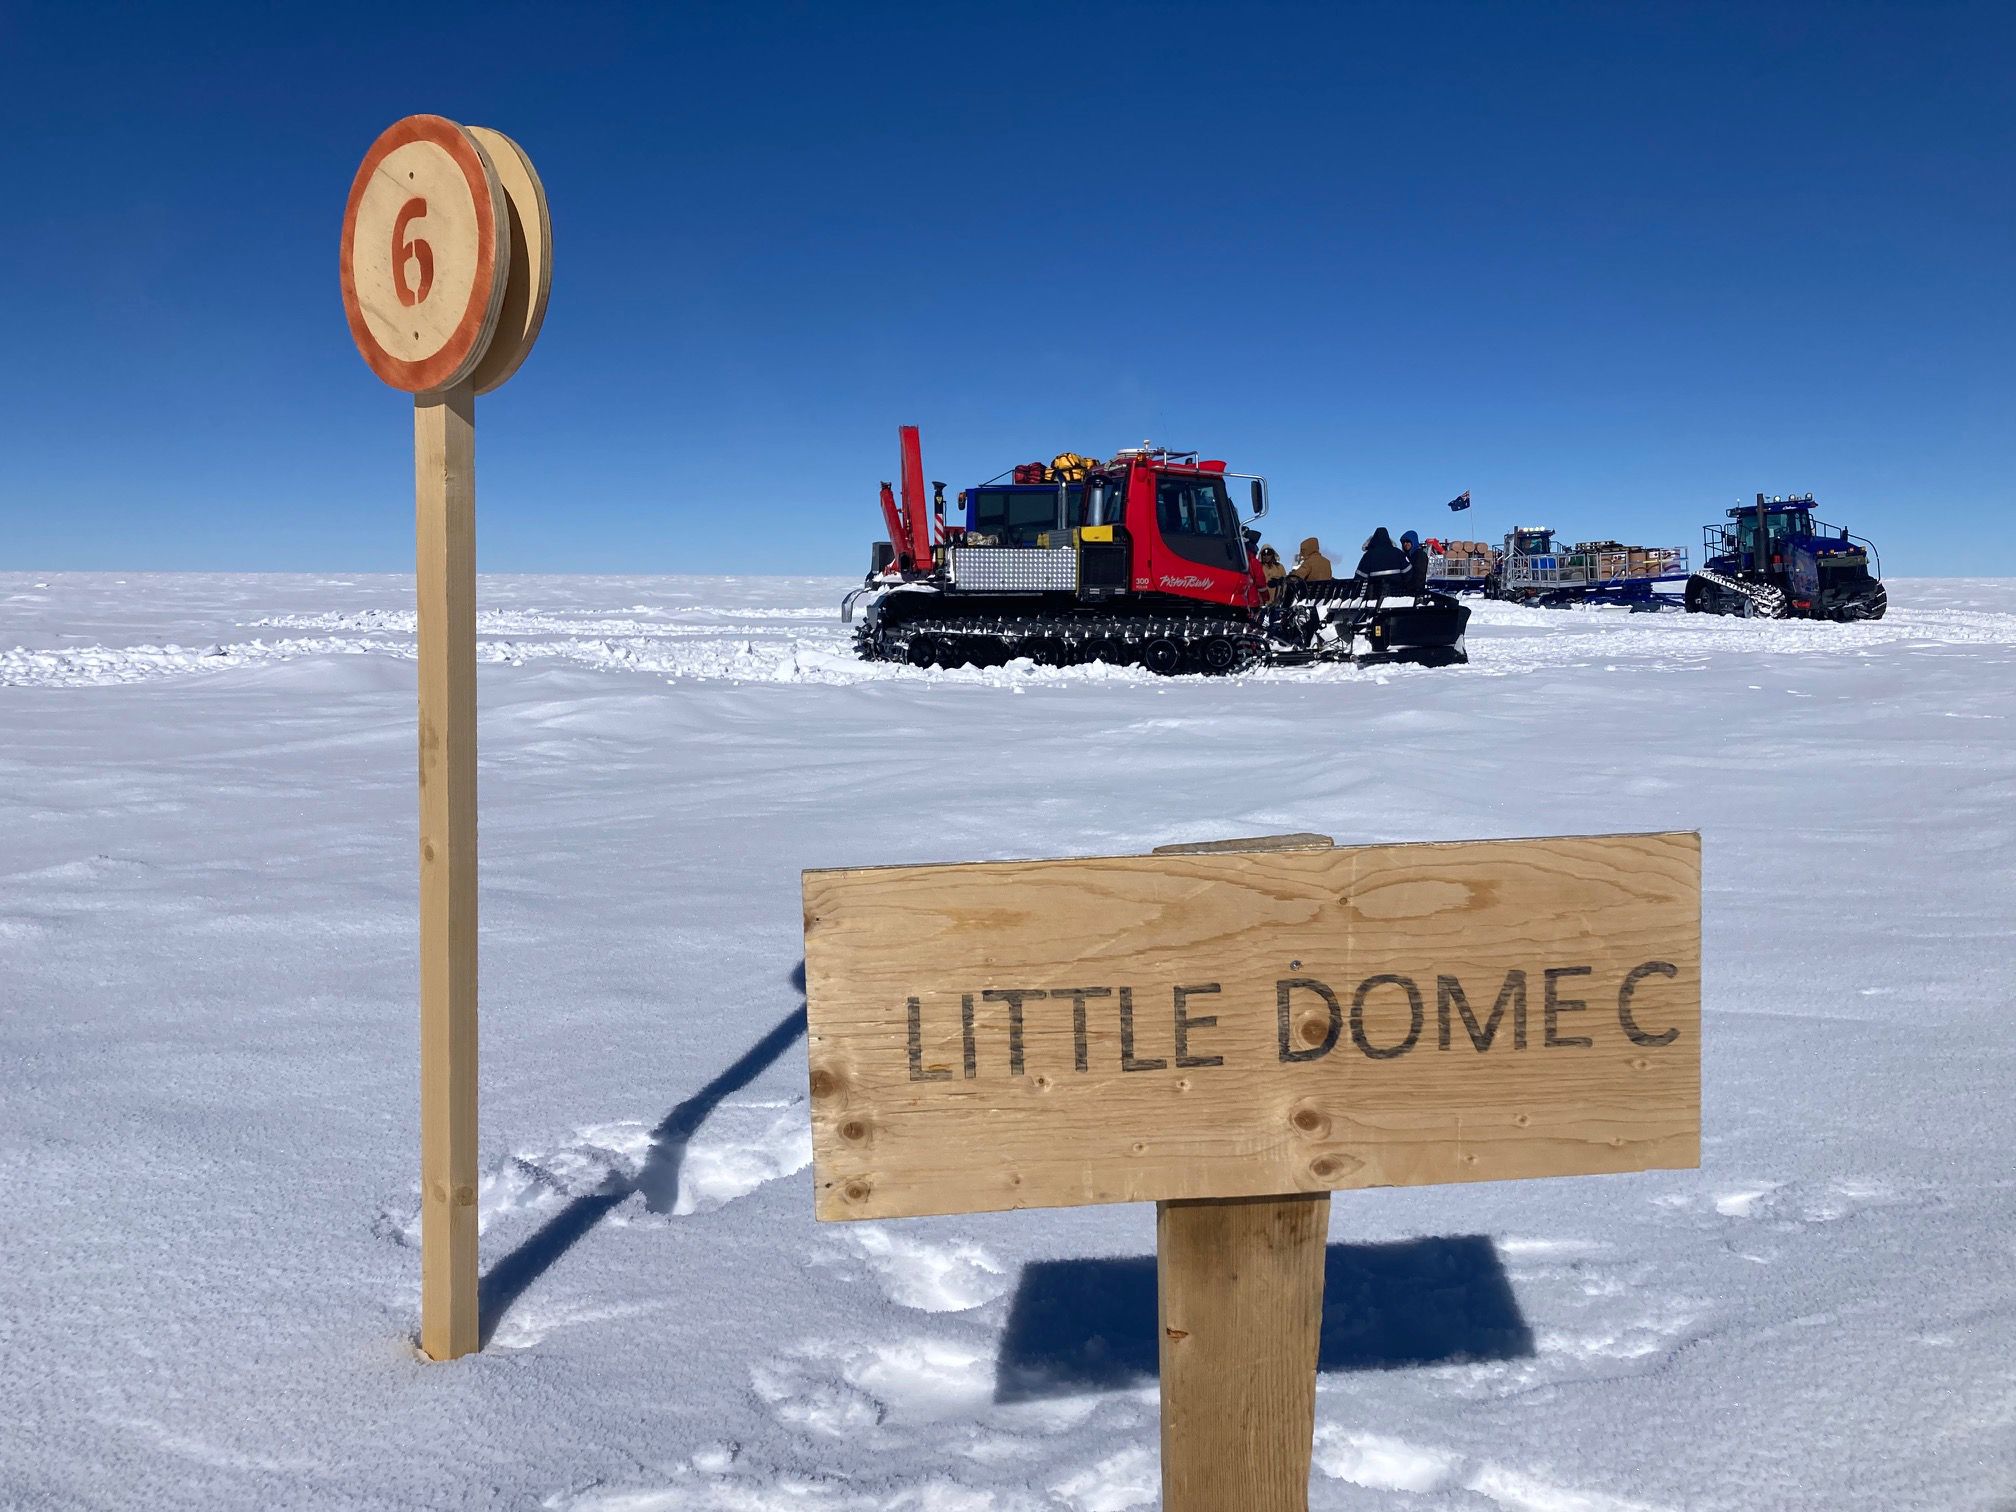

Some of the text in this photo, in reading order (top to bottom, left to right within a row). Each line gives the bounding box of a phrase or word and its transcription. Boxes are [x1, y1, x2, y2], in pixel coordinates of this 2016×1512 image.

[392, 197, 434, 306] 6
[1135, 577, 1149, 585] 300
[908, 984, 1222, 1081] LITTLE
